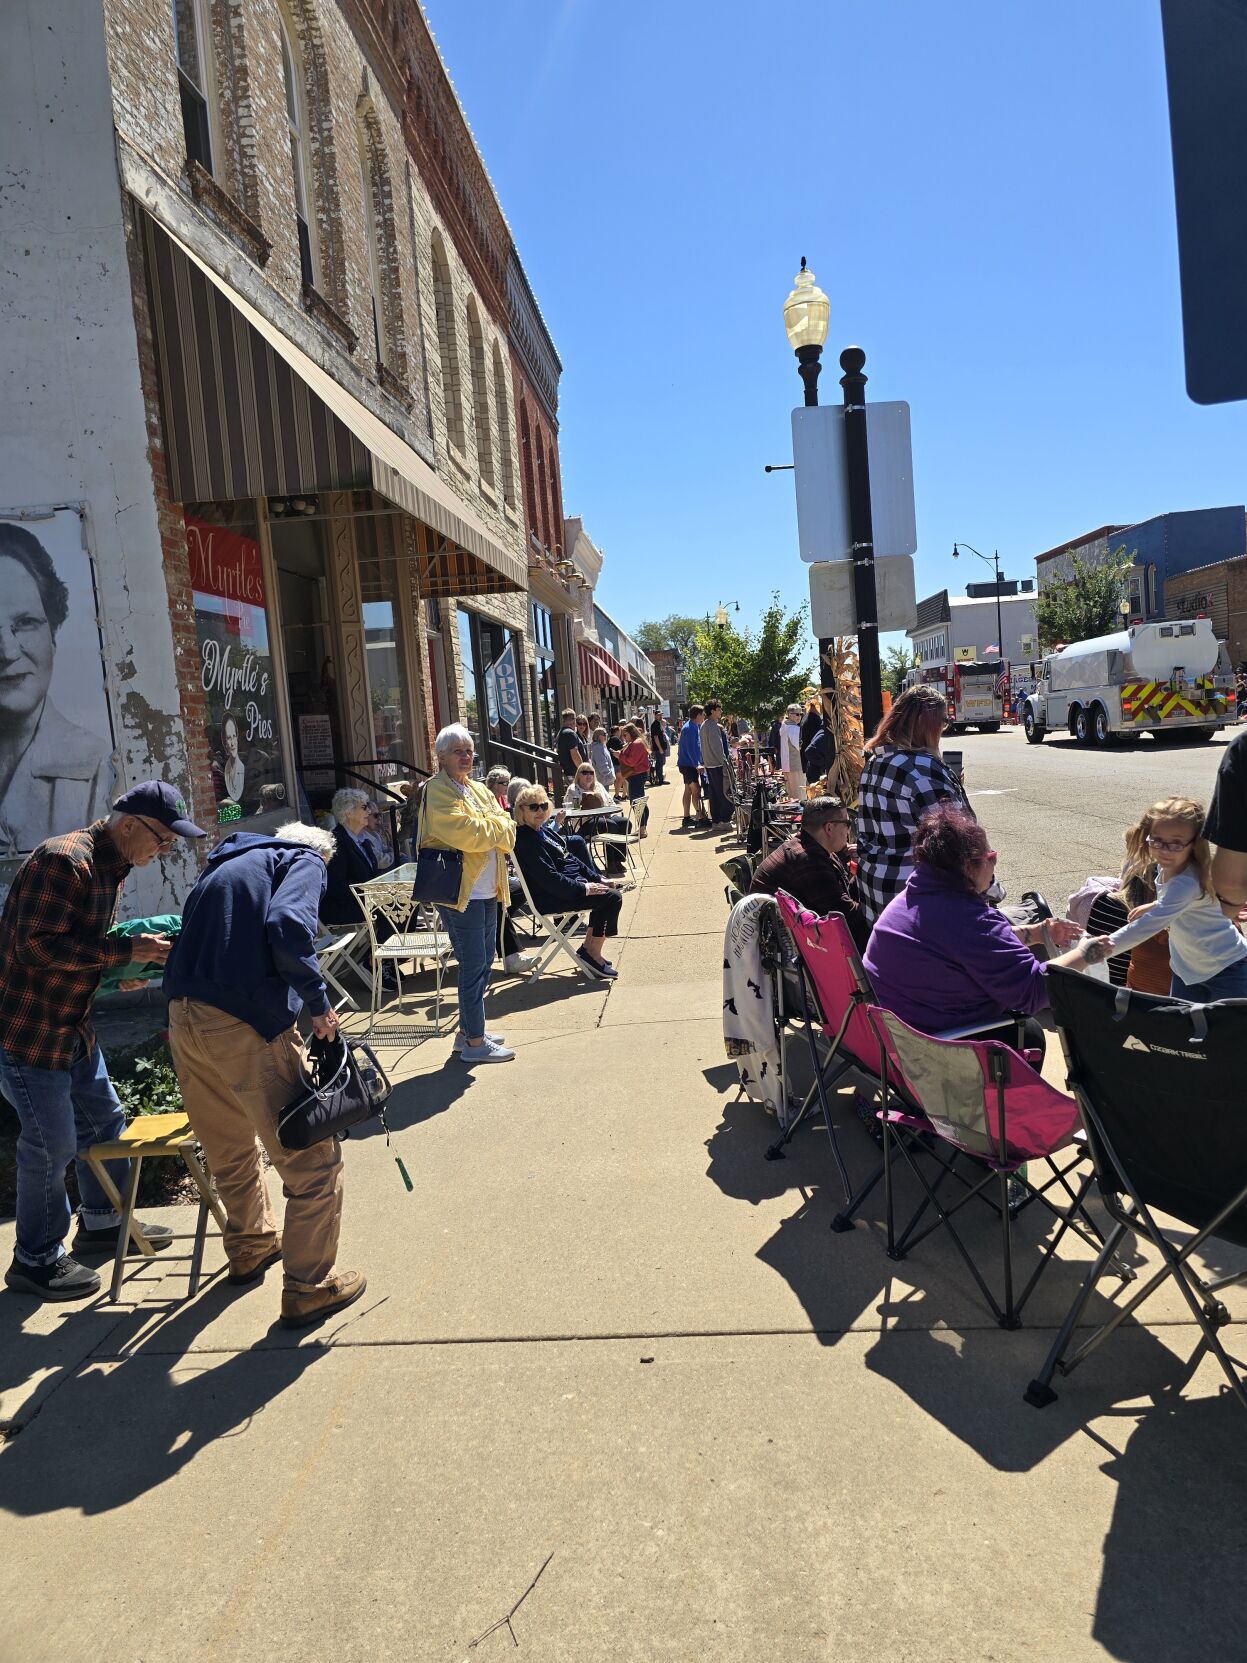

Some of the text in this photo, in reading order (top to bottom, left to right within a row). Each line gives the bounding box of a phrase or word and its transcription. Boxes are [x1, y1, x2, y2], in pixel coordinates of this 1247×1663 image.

[186, 525, 263, 624] Myrtle's
[202, 638, 269, 710] Myrtle's
[245, 701, 273, 741] Pies
